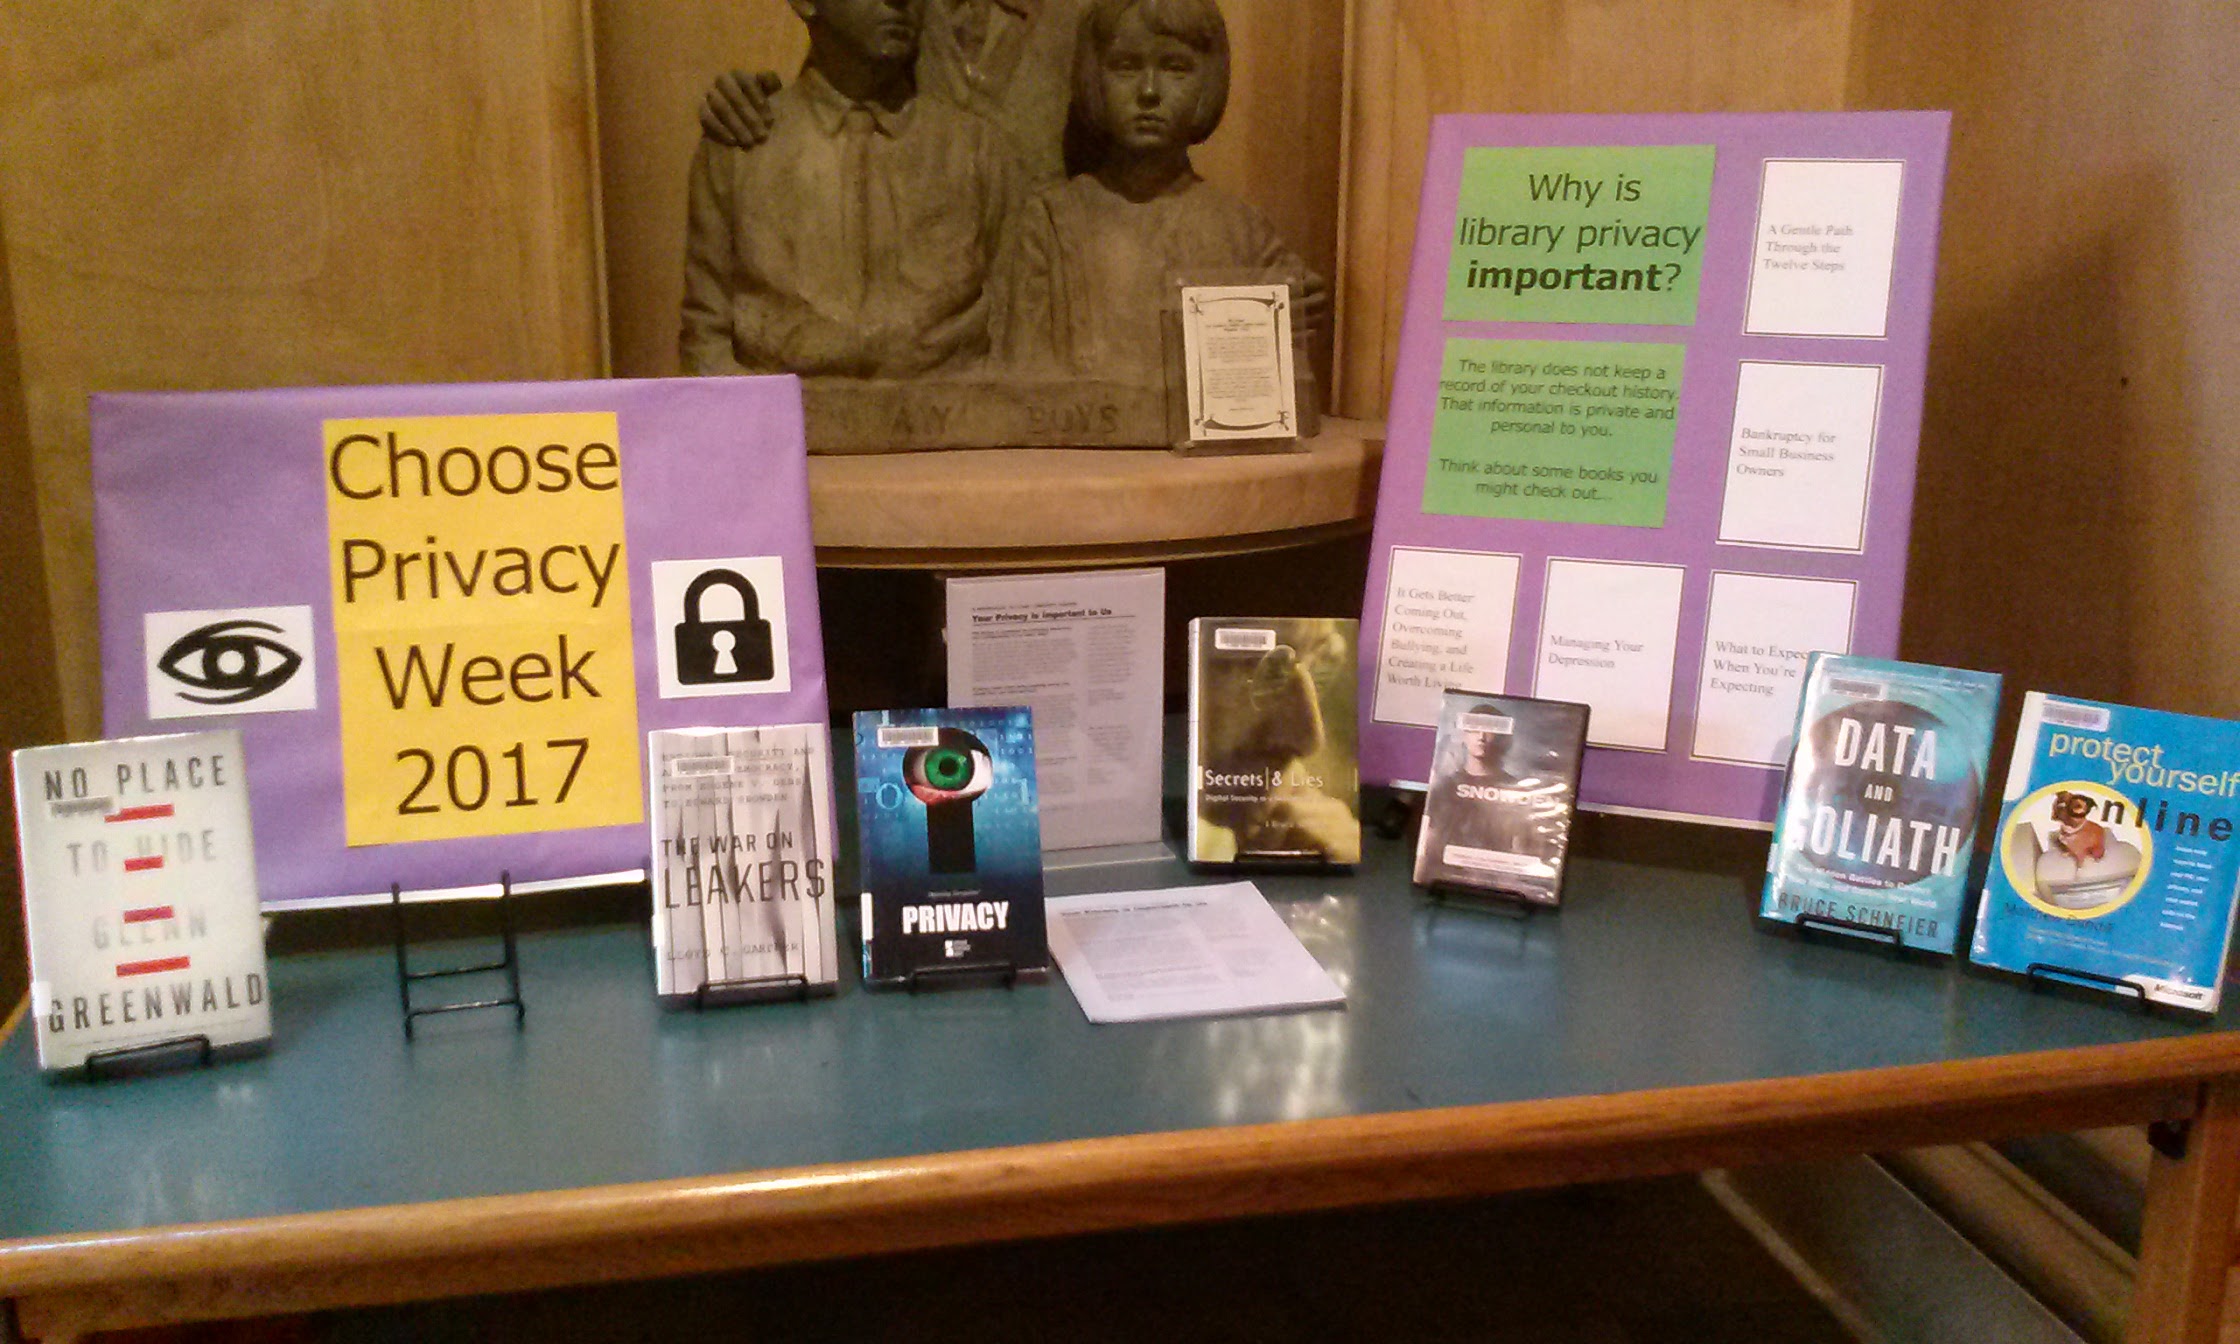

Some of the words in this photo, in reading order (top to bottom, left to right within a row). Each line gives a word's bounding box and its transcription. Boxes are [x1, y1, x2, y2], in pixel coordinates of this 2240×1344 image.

[1529, 173, 1603, 208] Why
[1615, 173, 1642, 202] is
[1459, 216, 1565, 253] library
[1576, 219, 1702, 255] privacy
[1769, 225, 1777, 235] A
[1781, 224, 1821, 235] Gentle
[1826, 224, 1854, 236] Path
[1766, 241, 1817, 256] Through
[1821, 242, 1841, 253] the
[1763, 258, 1808, 270] Twelve
[1812, 261, 1845, 273] Steps
[1466, 259, 1682, 296] important?
[1459, 359, 1486, 373] The
[1490, 360, 1536, 377] library
[1542, 362, 1578, 376] does
[1584, 365, 1609, 378] not
[1614, 364, 1650, 381] keep
[1656, 368, 1666, 379] a
[1439, 380, 1485, 392] record
[1491, 379, 1507, 393] of
[1510, 384, 1543, 400] your
[1549, 381, 1618, 398] checkout
[1442, 396, 1473, 411] That
[1479, 398, 1564, 415] information
[1569, 403, 1581, 416] is
[1586, 403, 1639, 419] private
[1644, 405, 1675, 420] and
[1491, 419, 1554, 434] personal
[1560, 421, 1575, 435] to
[1580, 425, 1613, 438] you.
[1742, 428, 1811, 444] Bankruptcy
[1818, 432, 1836, 443] for
[1739, 446, 1774, 458] Small
[1780, 448, 1834, 461] Business
[330, 432, 619, 499] Choose
[1440, 458, 1478, 474] Think
[1484, 460, 1527, 476] about
[1532, 466, 1574, 479] some
[1579, 465, 1624, 481] books
[1630, 471, 1657, 484] you
[1736, 463, 1784, 476] Owners
[1476, 481, 1517, 498] might
[1523, 481, 1566, 498] check
[343, 536, 621, 609] Privacy
[1397, 587, 1405, 598] It
[1409, 588, 1434, 599] Gets
[1438, 590, 1475, 603] Better
[995, 612, 1028, 622] Privacy
[1394, 604, 1440, 620] Coming
[1392, 621, 1463, 638] Overcoming
[1445, 645, 1467, 655] and
[1551, 635, 1610, 653] Managing
[1614, 640, 1644, 652] Your
[1715, 640, 1748, 655] What
[1752, 646, 1764, 656] to
[1769, 645, 1808, 660] Expec
[1388, 656, 1437, 673] Creating
[1440, 663, 1446, 672] a
[1450, 661, 1474, 674] Life
[1548, 653, 1615, 668] Depression
[1713, 659, 1749, 673] When
[1754, 662, 1796, 677] You're
[376, 635, 602, 710] Week
[1387, 673, 1421, 687] Worth
[1710, 677, 1774, 696] Expecting
[1834, 717, 1937, 781] DATA
[2049, 731, 2164, 769] protect
[44, 767, 89, 802] NO
[116, 755, 227, 796] PLACE
[395, 738, 591, 817] 2017
[1205, 769, 1264, 787] Secrets
[1271, 770, 1283, 787] &
[1291, 770, 1324, 788] Lies
[2106, 759, 2240, 798] yourself
[1864, 784, 1894, 803] AND
[66, 840, 109, 878] TO
[136, 830, 218, 863] HIDE
[661, 836, 700, 858] THE
[709, 833, 757, 854] WAR
[766, 832, 794, 850] ON
[664, 859, 825, 909] LEAKERS
[902, 901, 1009, 935] PRIVACY
[1777, 891, 1837, 918] BRUCE
[1846, 904, 1939, 939] SCHNEIER
[49, 972, 264, 1033] GREENWALD
